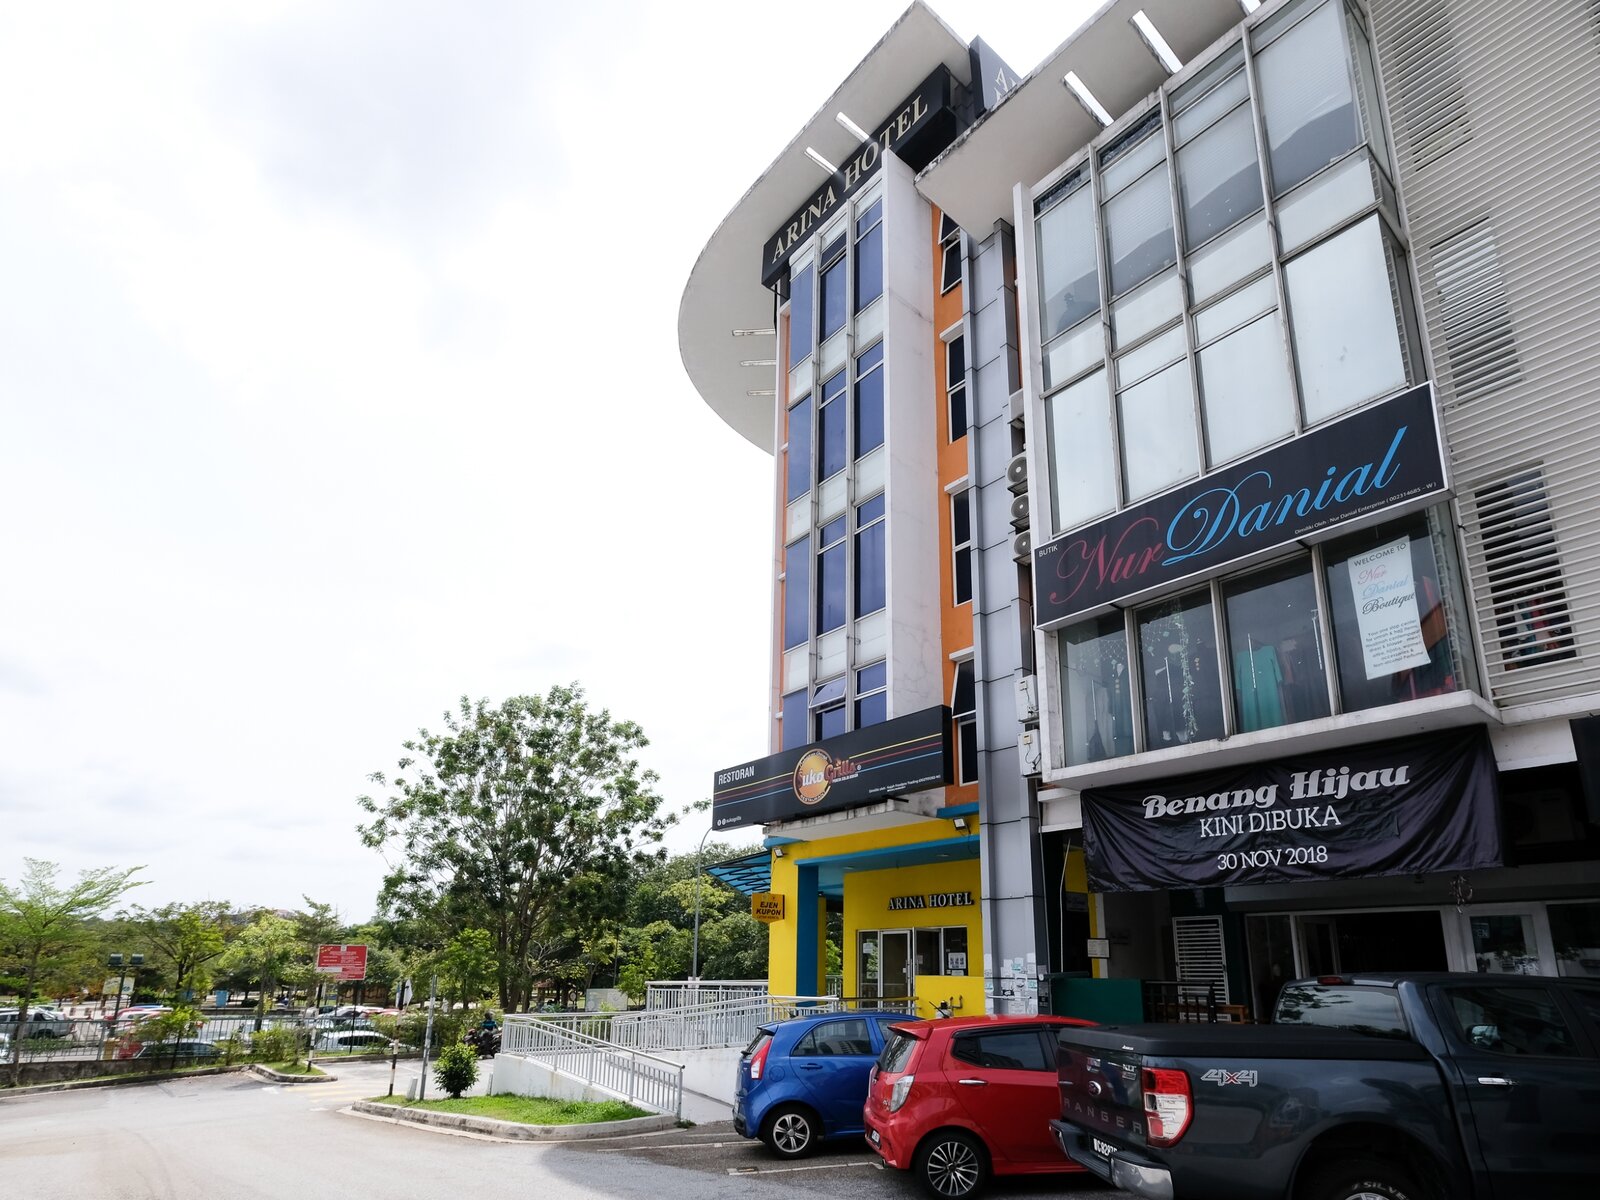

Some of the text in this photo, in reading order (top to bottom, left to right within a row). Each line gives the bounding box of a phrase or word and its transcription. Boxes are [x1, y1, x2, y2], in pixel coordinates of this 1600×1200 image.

[772, 95, 928, 263] ARINA HOTEL
[1049, 425, 1408, 605] Nur Danial
[1038, 544, 1058, 558] BUTIK
[1353, 543, 1407, 567] WELCOME TO
[1362, 592, 1415, 615] Boutique
[718, 766, 754, 784] RESTORAN
[1142, 765, 1410, 818] Benang Hijau
[1200, 805, 1341, 838] KINI DIBUKA
[1217, 846, 1328, 870] 30 NOV 2018
[756, 908, 782, 916] KUPON
[888, 892, 974, 911] ARINA HOTEL
[1063, 1097, 1143, 1135] RANGER
